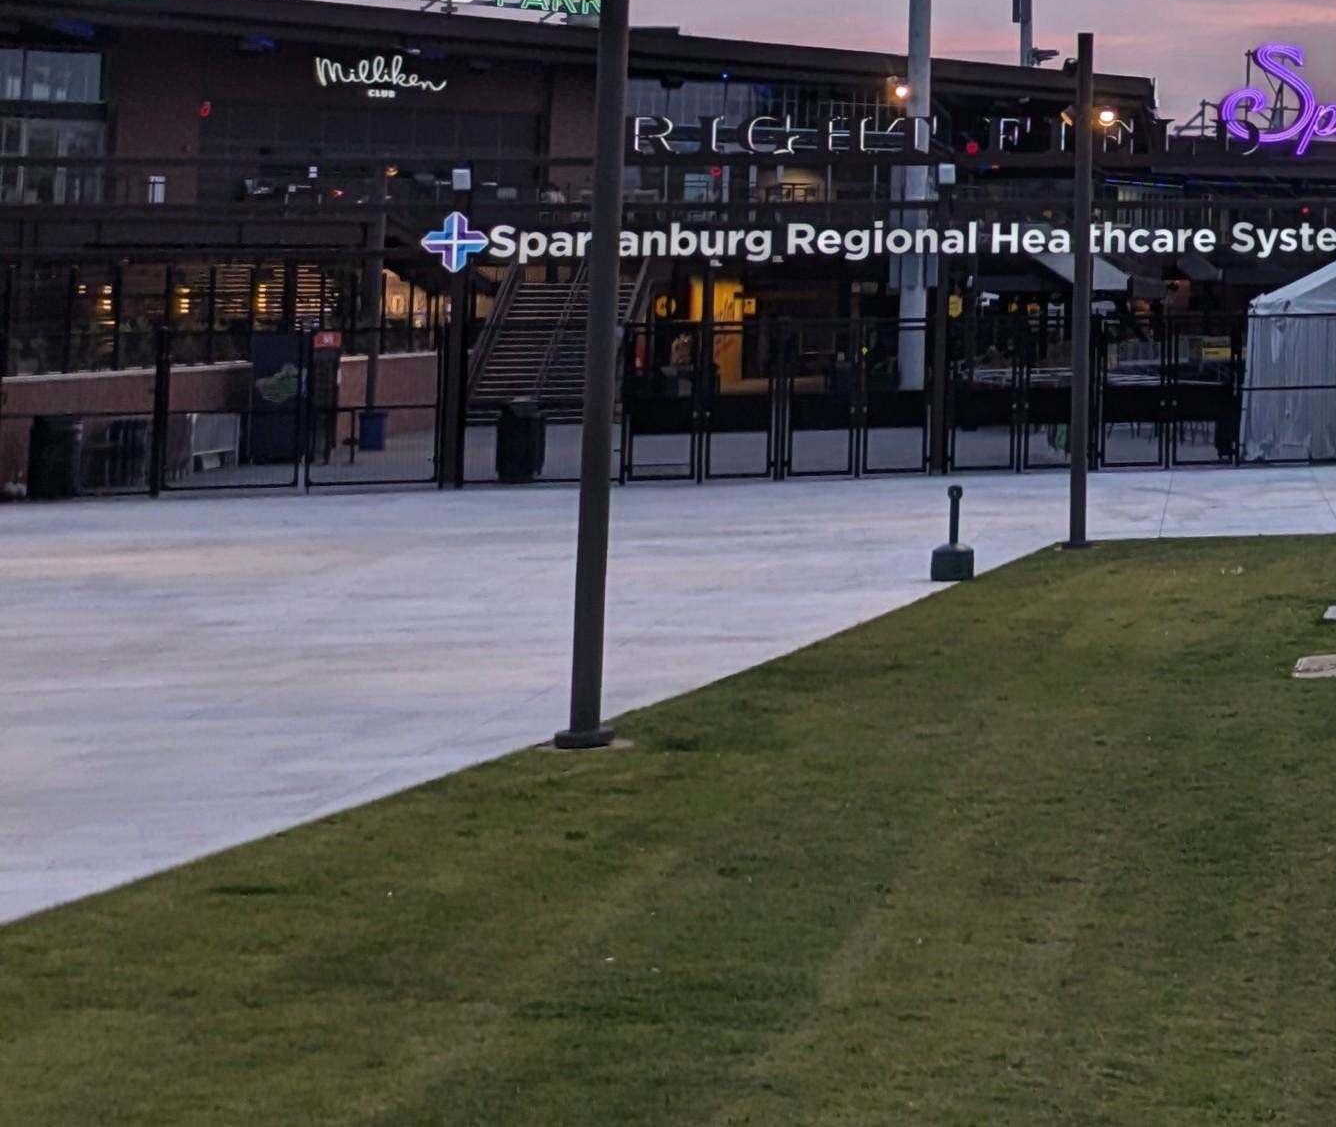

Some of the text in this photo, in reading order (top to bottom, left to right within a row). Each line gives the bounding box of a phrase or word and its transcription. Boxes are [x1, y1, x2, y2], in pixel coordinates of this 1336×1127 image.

[315, 55, 448, 92] Milliken
[367, 89, 396, 98] CLUB
[489, 222, 772, 264] Sparanburg
[786, 220, 977, 261] Regional
[991, 221, 1216, 254] Heathcare
